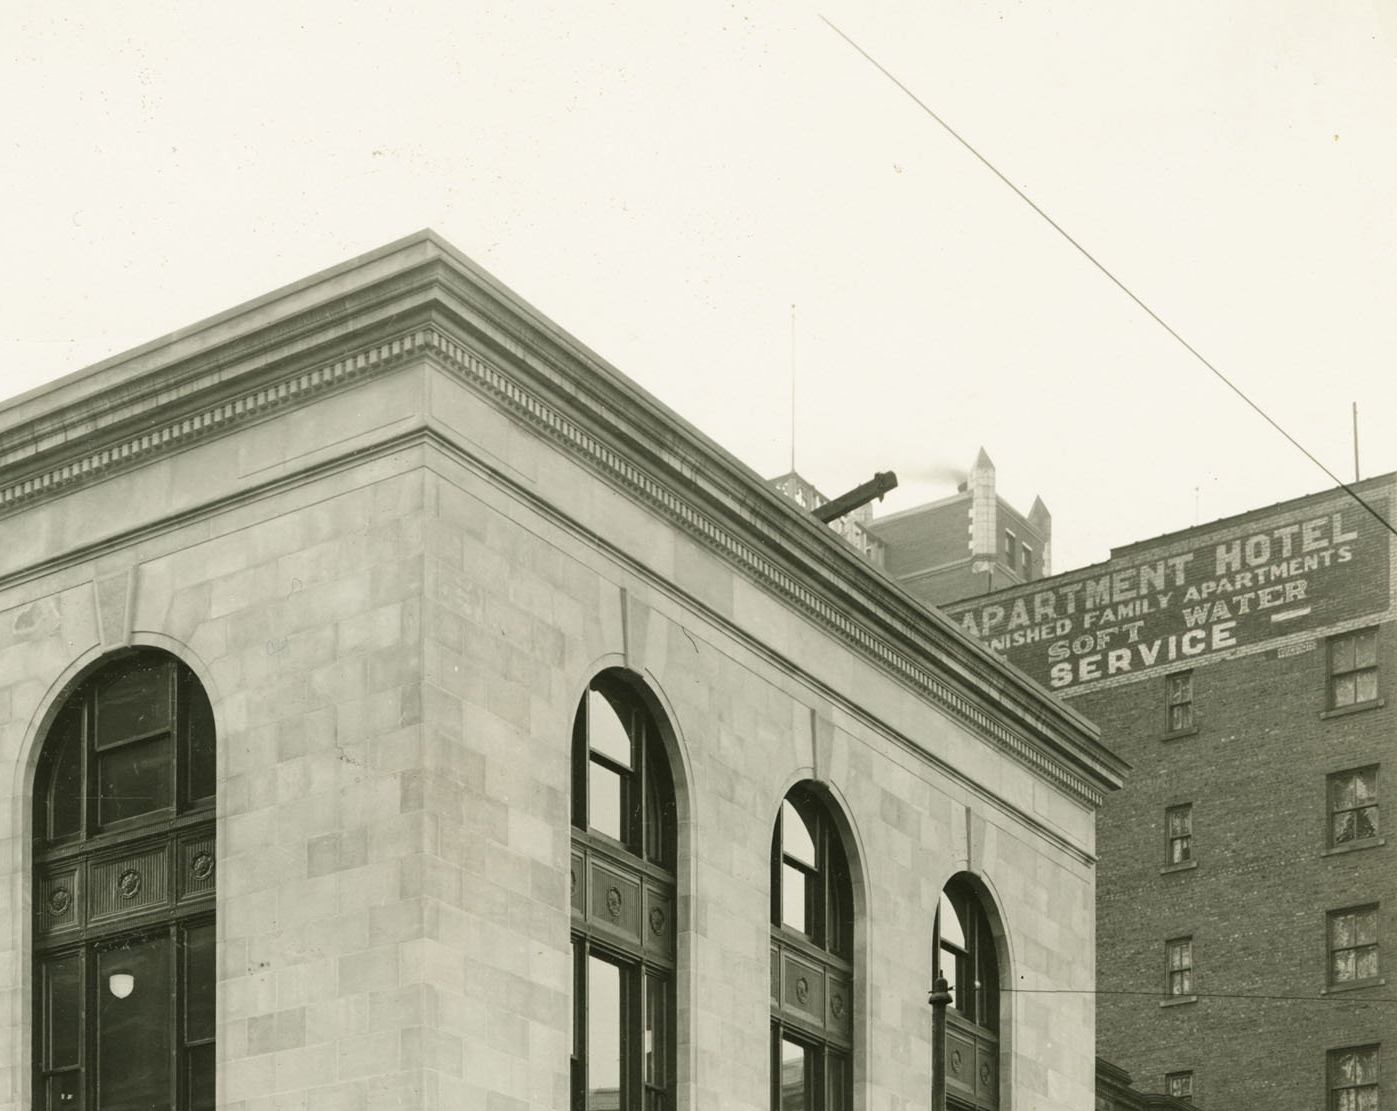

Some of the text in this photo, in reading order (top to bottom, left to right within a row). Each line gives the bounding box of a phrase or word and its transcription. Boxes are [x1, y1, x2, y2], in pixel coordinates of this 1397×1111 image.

[961, 513, 1358, 637] APARTMENT HOTEL
[984, 546, 1352, 650] NISHED FAMILY APARTMENTS
[1048, 579, 1308, 664] SOFT WATER
[1050, 620, 1237, 688] SERVICE
